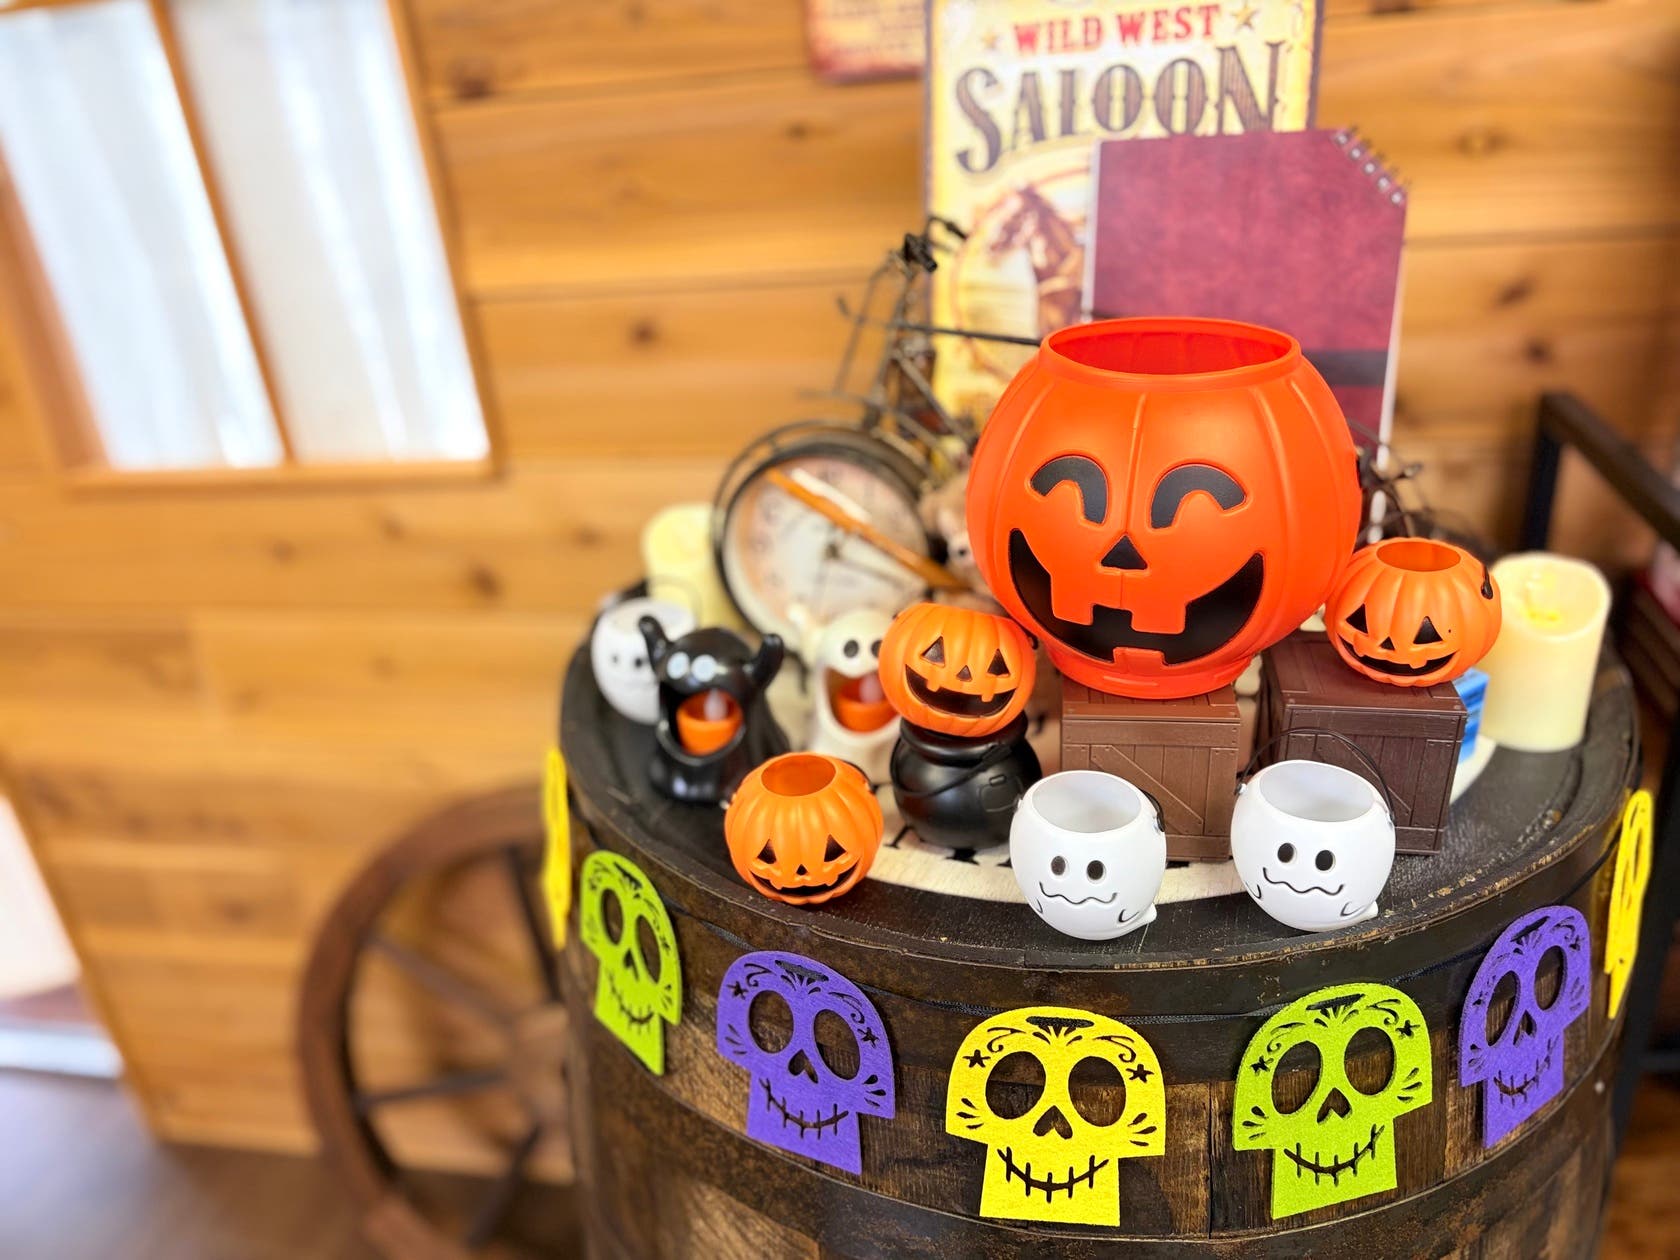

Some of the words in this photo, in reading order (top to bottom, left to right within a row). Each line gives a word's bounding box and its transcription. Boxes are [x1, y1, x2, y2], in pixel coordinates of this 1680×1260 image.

[1012, 16, 1103, 54] WILD
[1116, 4, 1222, 44] WEST
[955, 40, 1286, 174] SALOON
